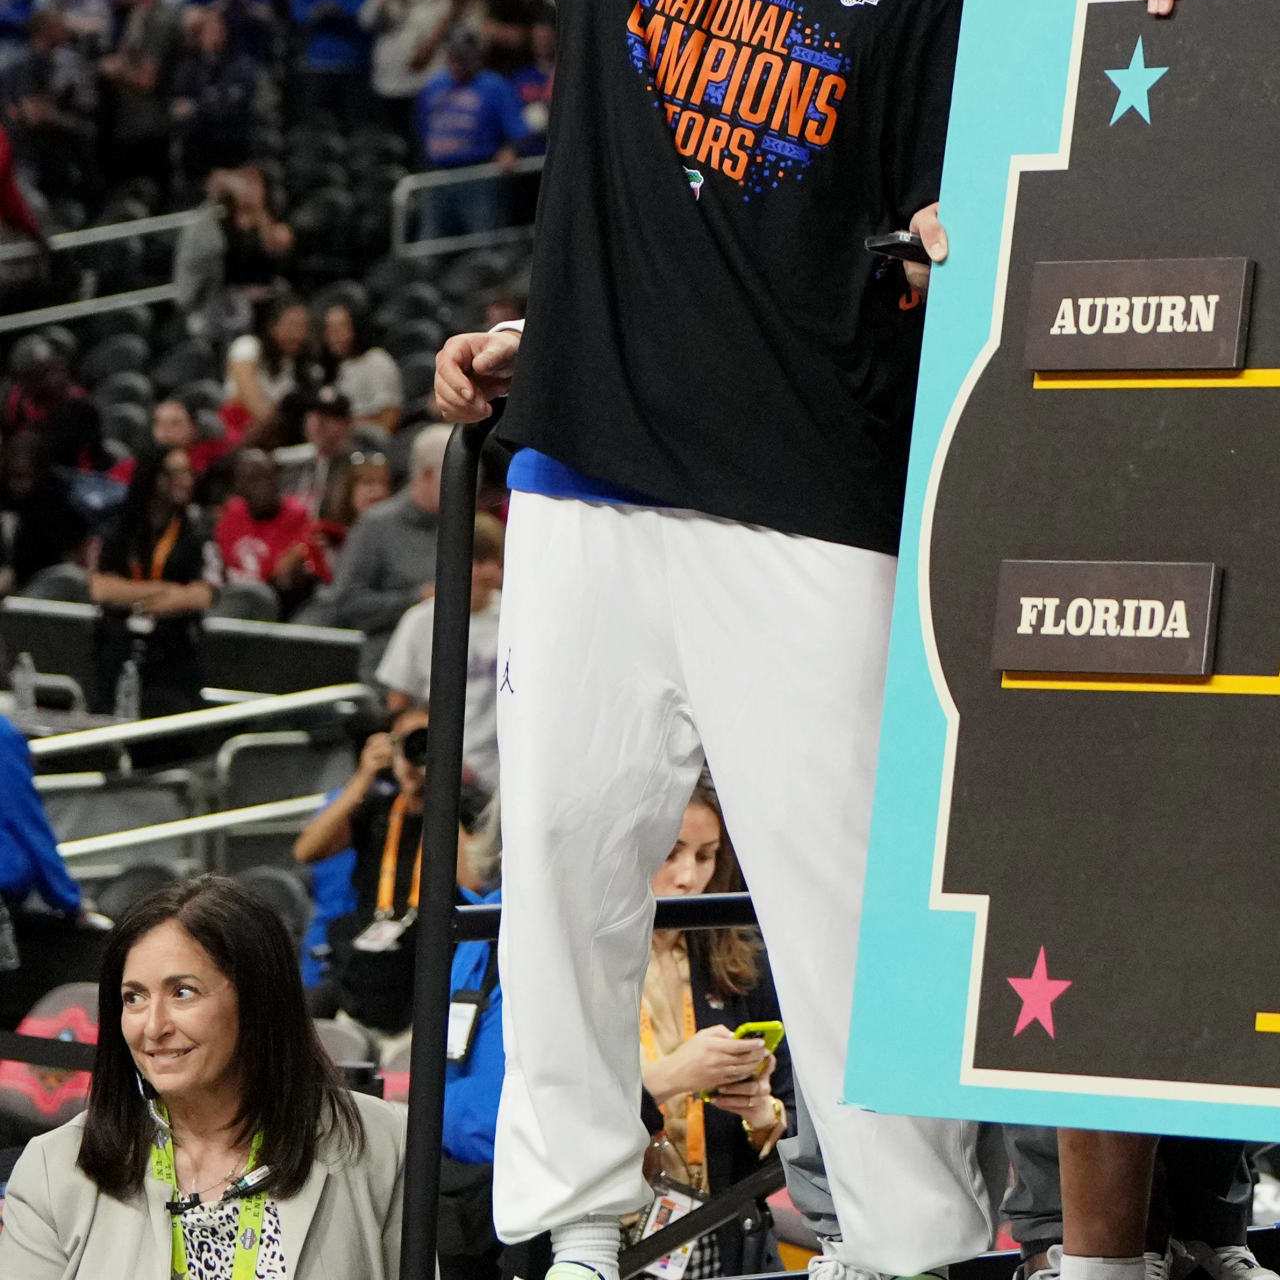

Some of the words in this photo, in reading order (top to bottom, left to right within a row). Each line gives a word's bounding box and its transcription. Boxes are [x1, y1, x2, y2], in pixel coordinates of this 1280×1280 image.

[626, 1, 848, 147] CAMPIONS
[664, 102, 755, 182] TORS
[1049, 294, 1220, 335] AUBURN
[1016, 596, 1191, 639] FLORIDA
